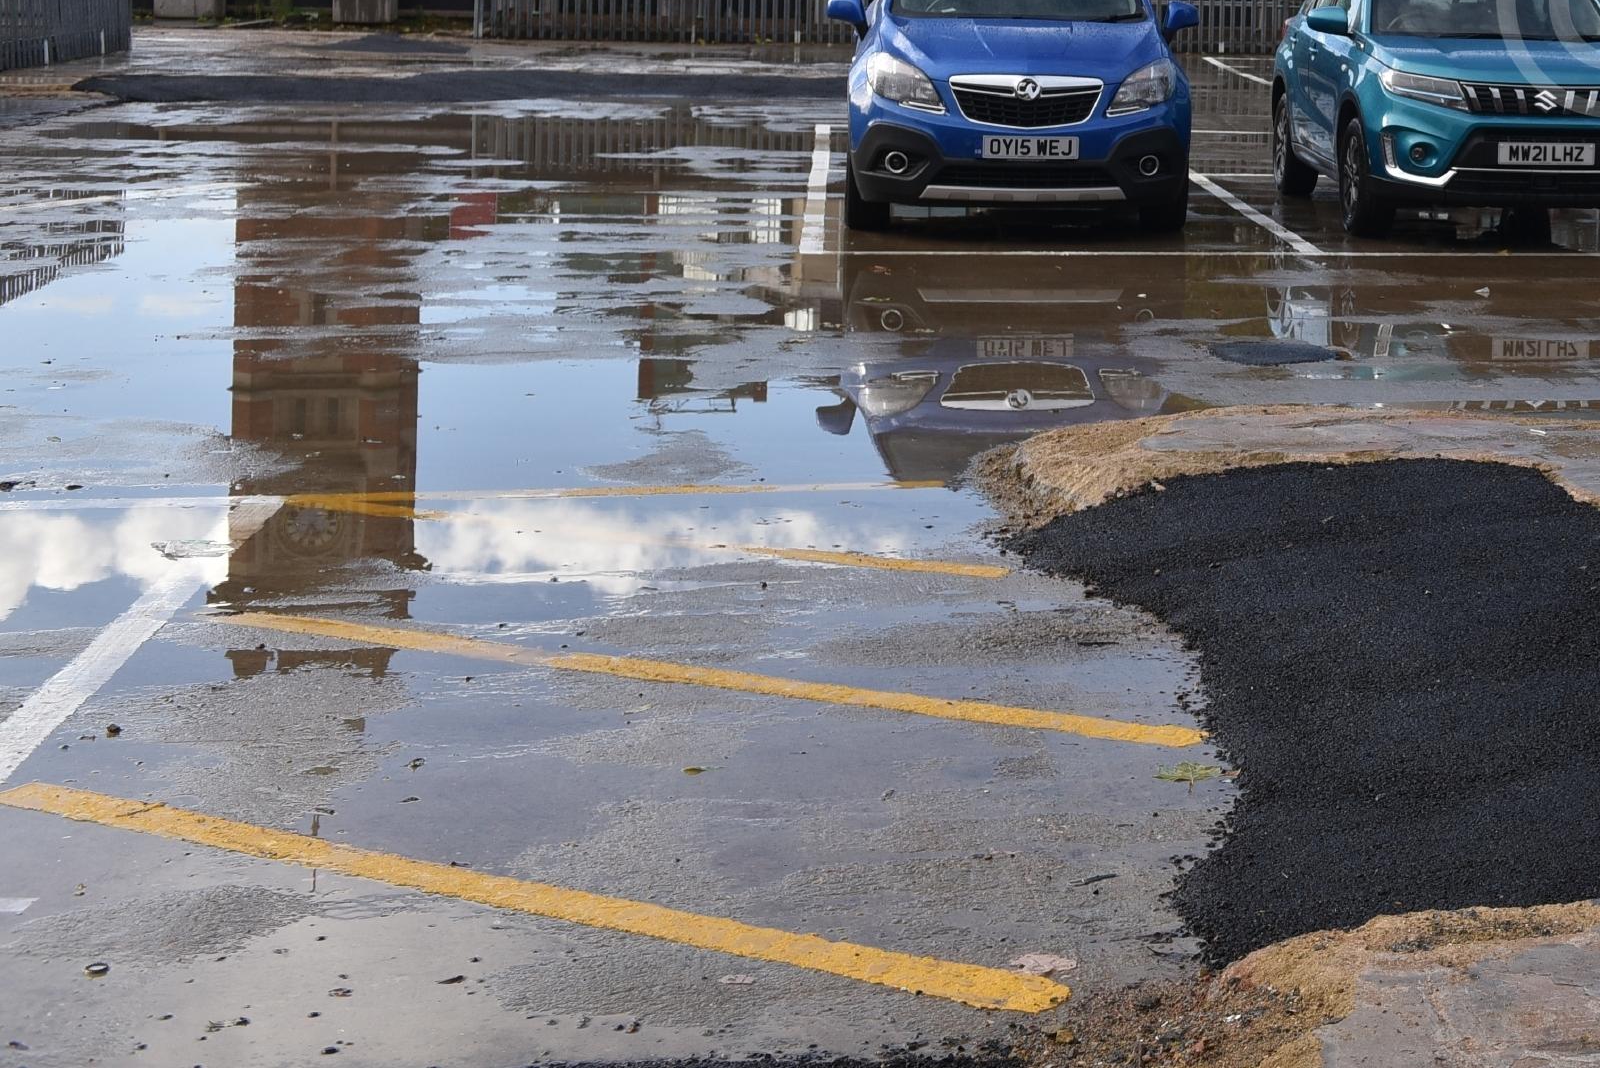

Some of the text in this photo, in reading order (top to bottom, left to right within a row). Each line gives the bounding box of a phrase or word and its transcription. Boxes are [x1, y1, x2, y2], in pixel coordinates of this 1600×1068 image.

[990, 139, 1072, 156] OY15 WEJ
[1509, 145, 1584, 162] MW21 LHZ
